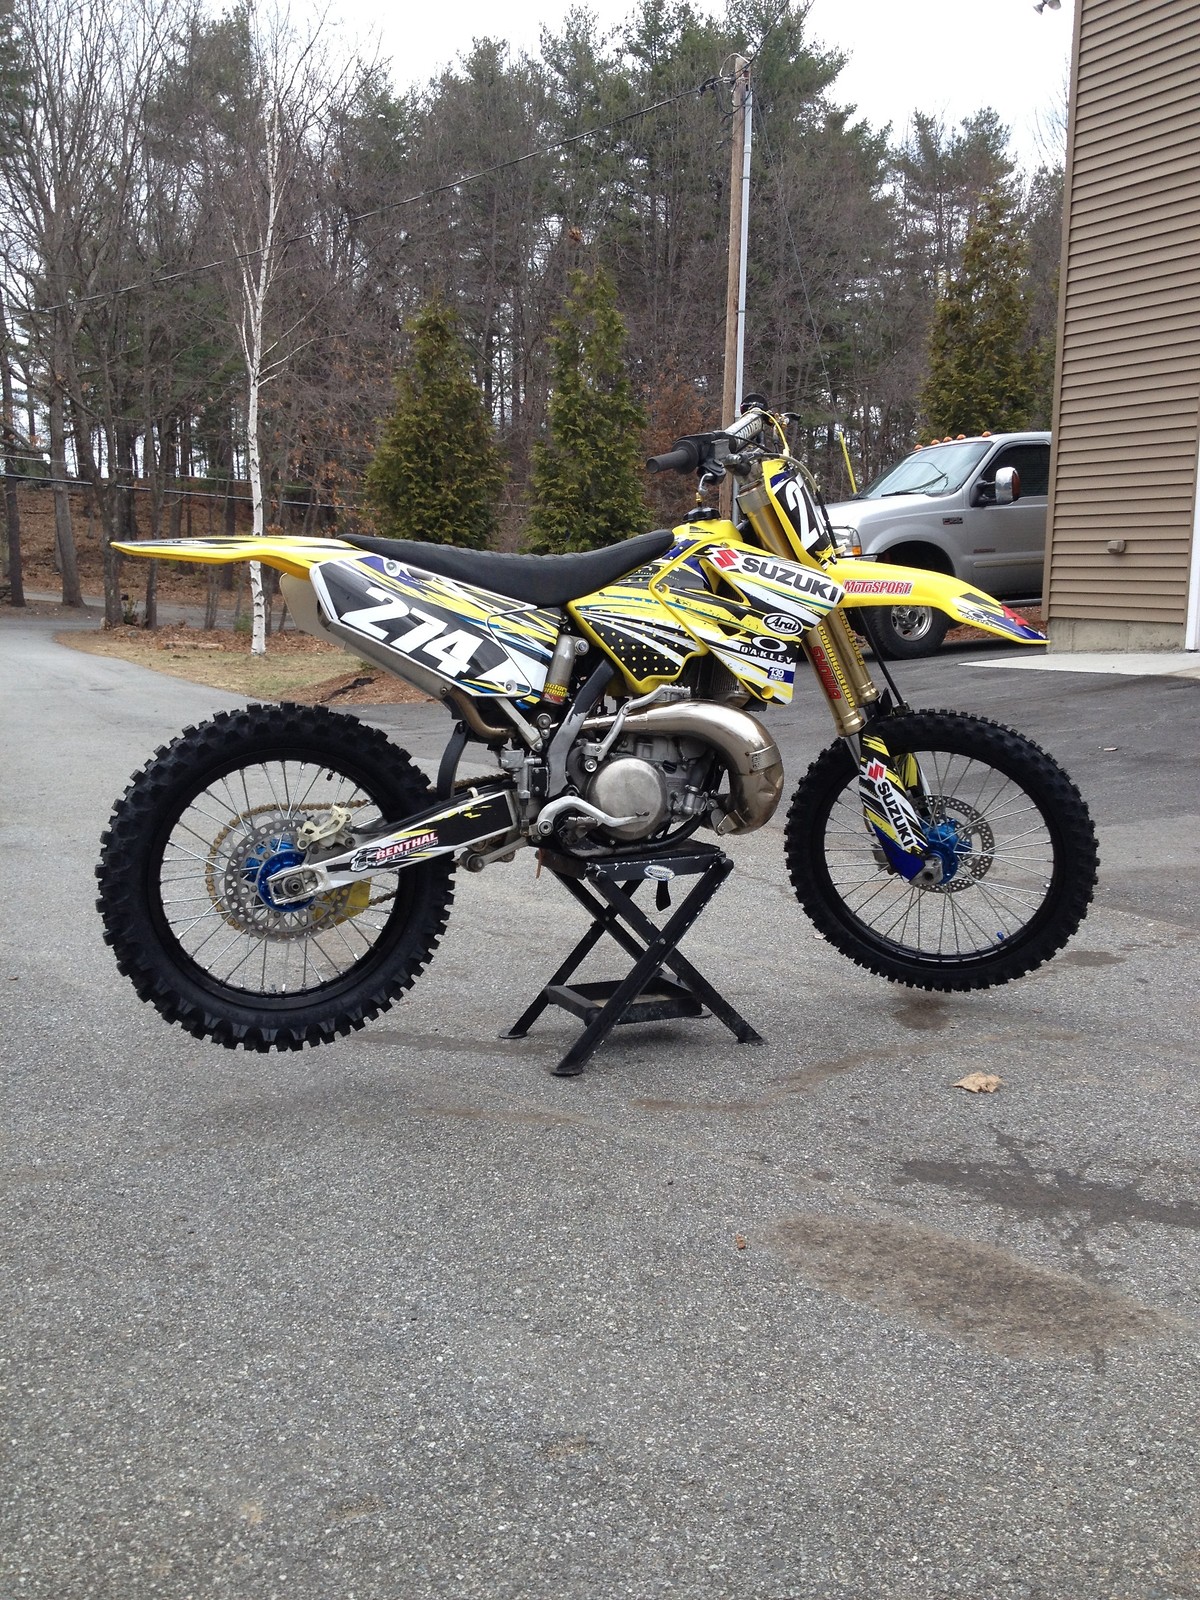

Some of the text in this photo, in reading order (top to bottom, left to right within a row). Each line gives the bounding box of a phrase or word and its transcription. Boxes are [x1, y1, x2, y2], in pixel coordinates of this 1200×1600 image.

[741, 557, 839, 602] SUZUKI
[340, 587, 484, 678] 274
[766, 616, 799, 631] Arai
[740, 646, 793, 664] OAKLEY
[769, 667, 785, 679] 139
[811, 645, 842, 700] SHOWA
[877, 781, 915, 847] SUZUKI
[376, 832, 438, 860] RENTHAL
